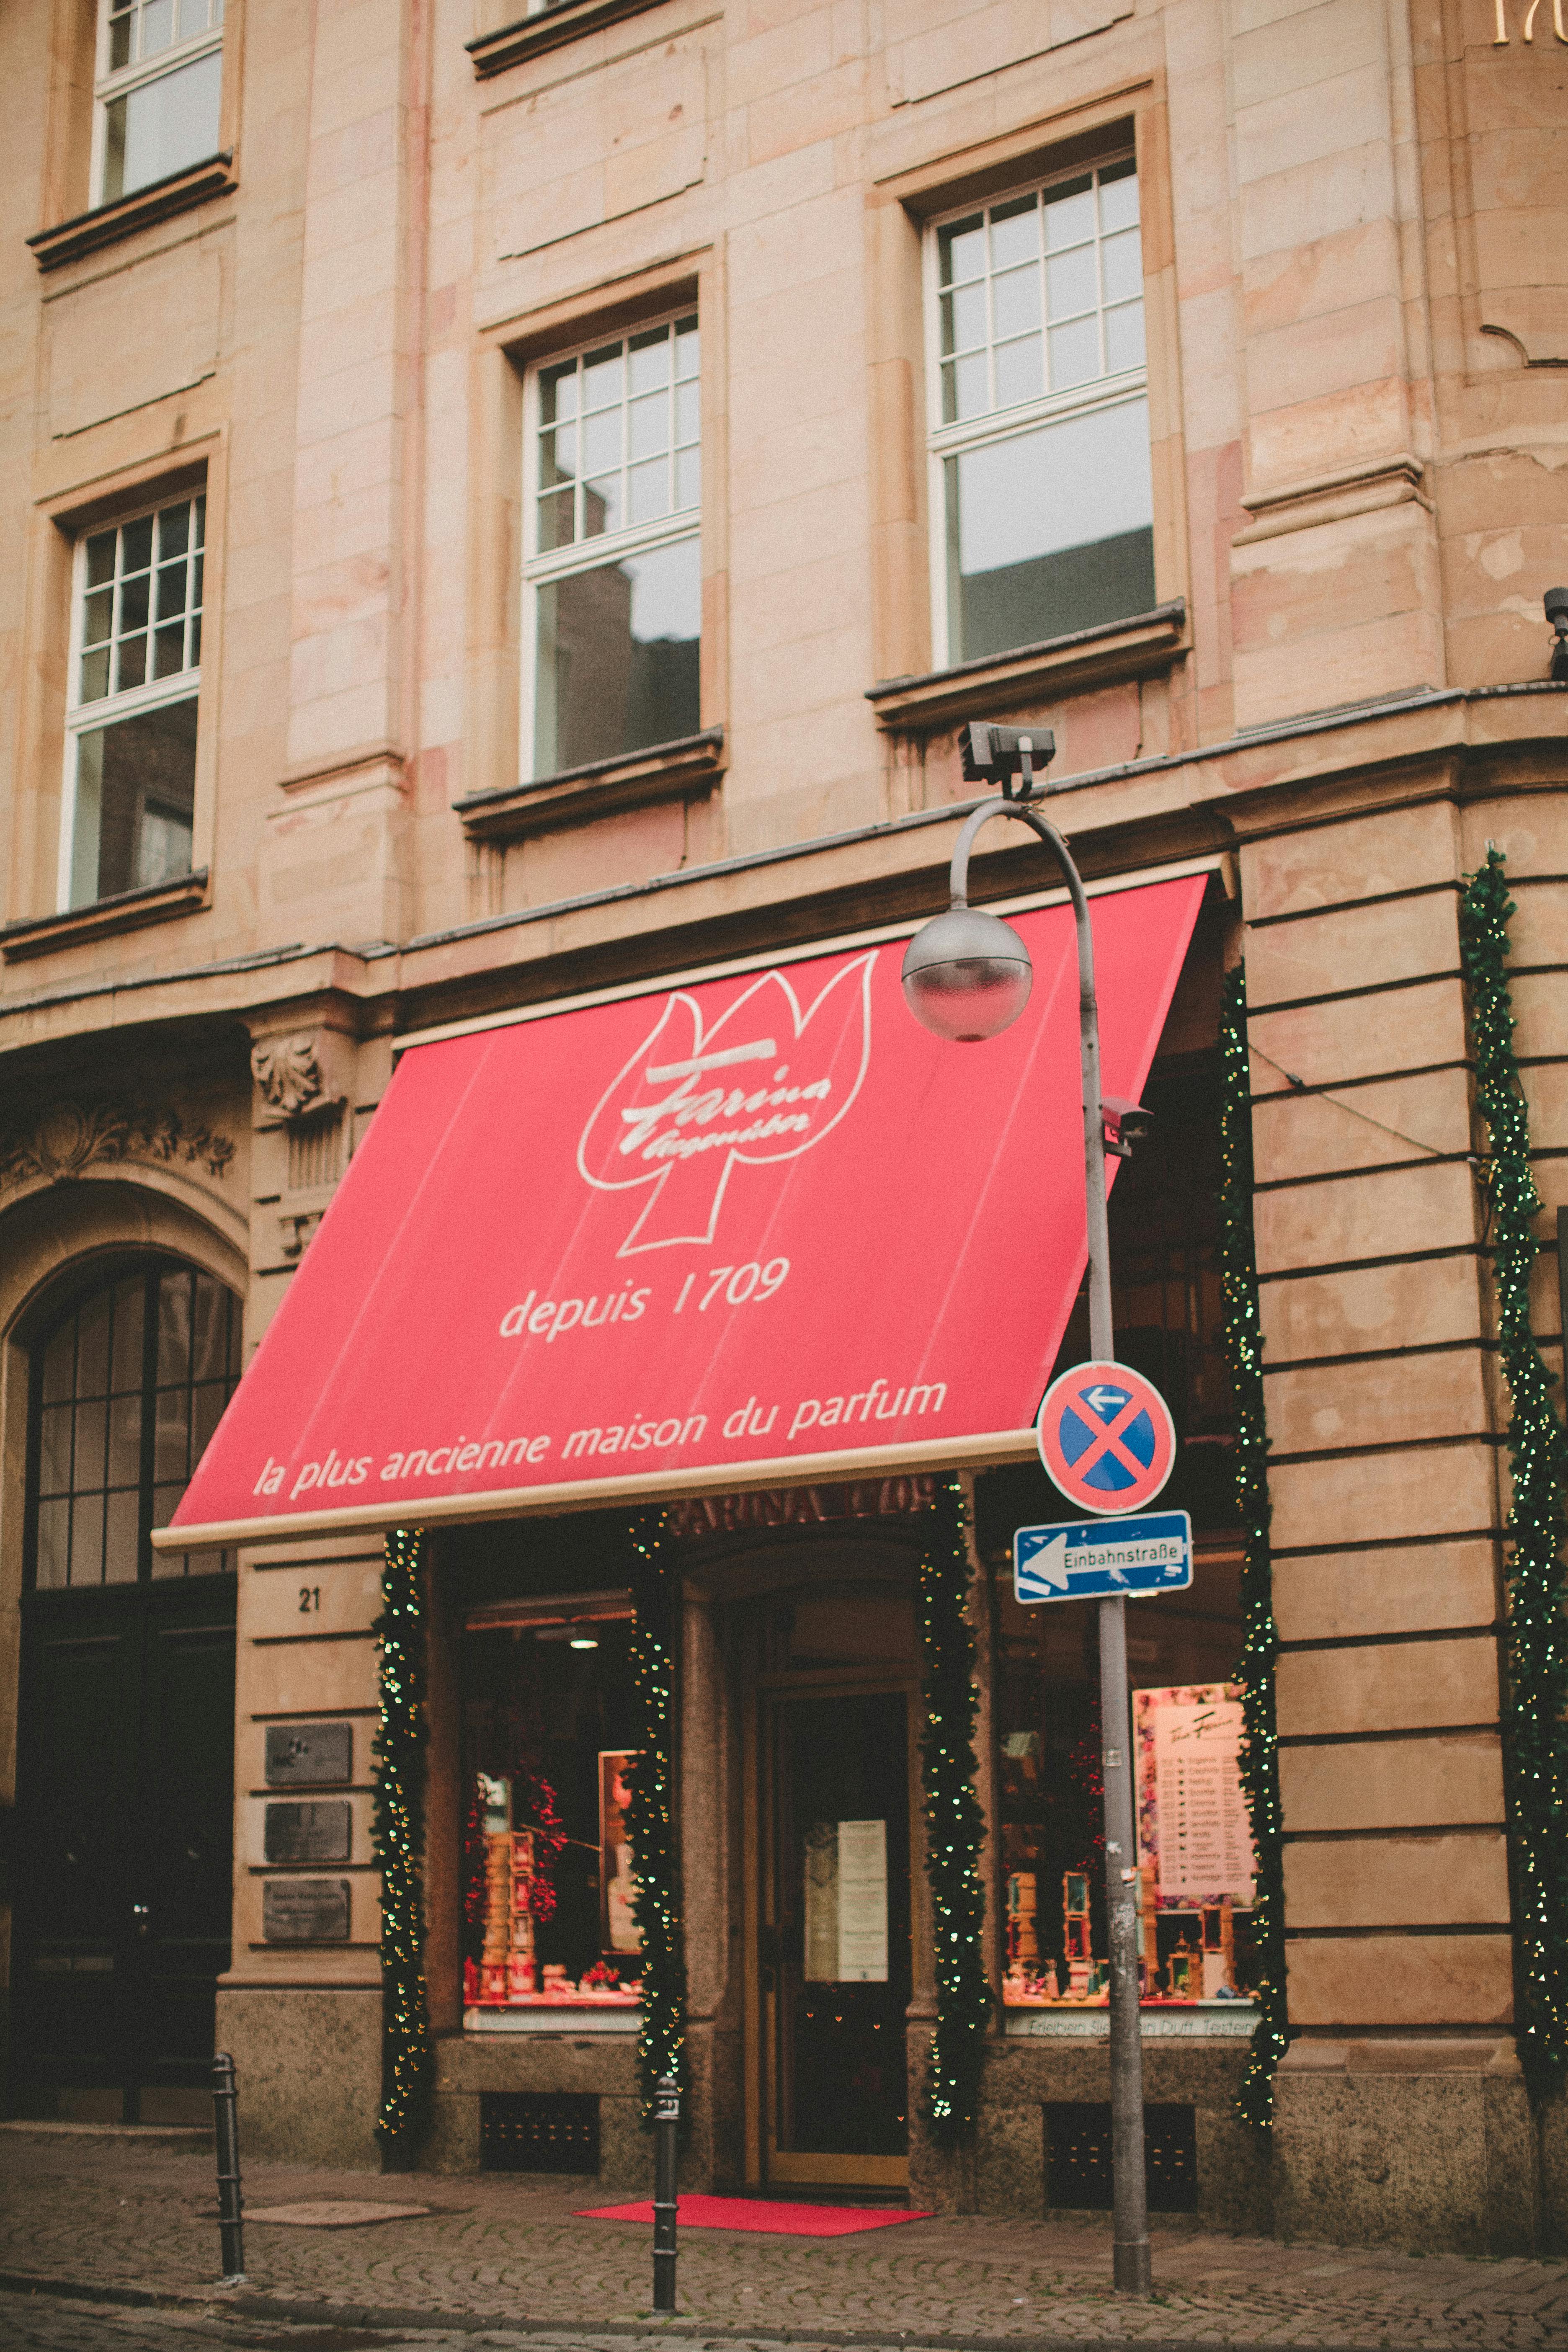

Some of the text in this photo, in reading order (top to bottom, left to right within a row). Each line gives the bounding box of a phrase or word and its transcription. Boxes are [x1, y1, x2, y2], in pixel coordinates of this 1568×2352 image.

[499, 1257, 790, 1343] depuis 1709
[252, 1378, 948, 1501] la plus ancienne maison du parfum
[1065, 1544, 1177, 1568] Einbahnstraße
[299, 1587, 320, 1612] 21
